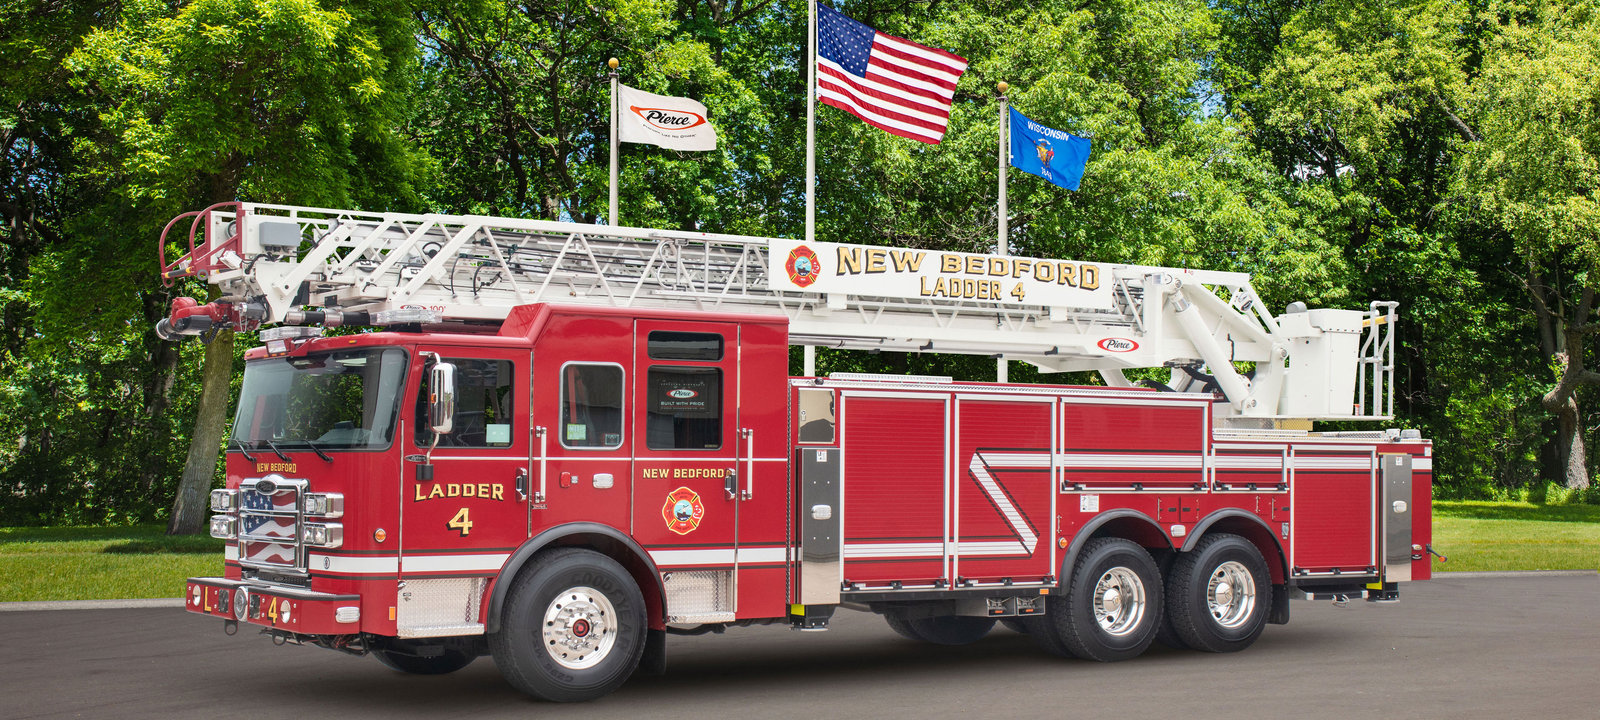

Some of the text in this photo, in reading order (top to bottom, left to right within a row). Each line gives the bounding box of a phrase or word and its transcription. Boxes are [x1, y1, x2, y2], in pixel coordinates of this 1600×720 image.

[647, 110, 690, 125] Pierce
[1027, 121, 1070, 141] WISCONSIN
[836, 246, 1100, 291] NEW BEDFORD
[920, 275, 1025, 302] LADDER 4
[1106, 339, 1130, 349] Pierce
[256, 463, 297, 474] NEW BEDFORD
[642, 468, 725, 478] NEW BEDFORD
[414, 483, 504, 502] LADDER
[445, 507, 473, 537] 4
[203, 586, 278, 626] L 4
